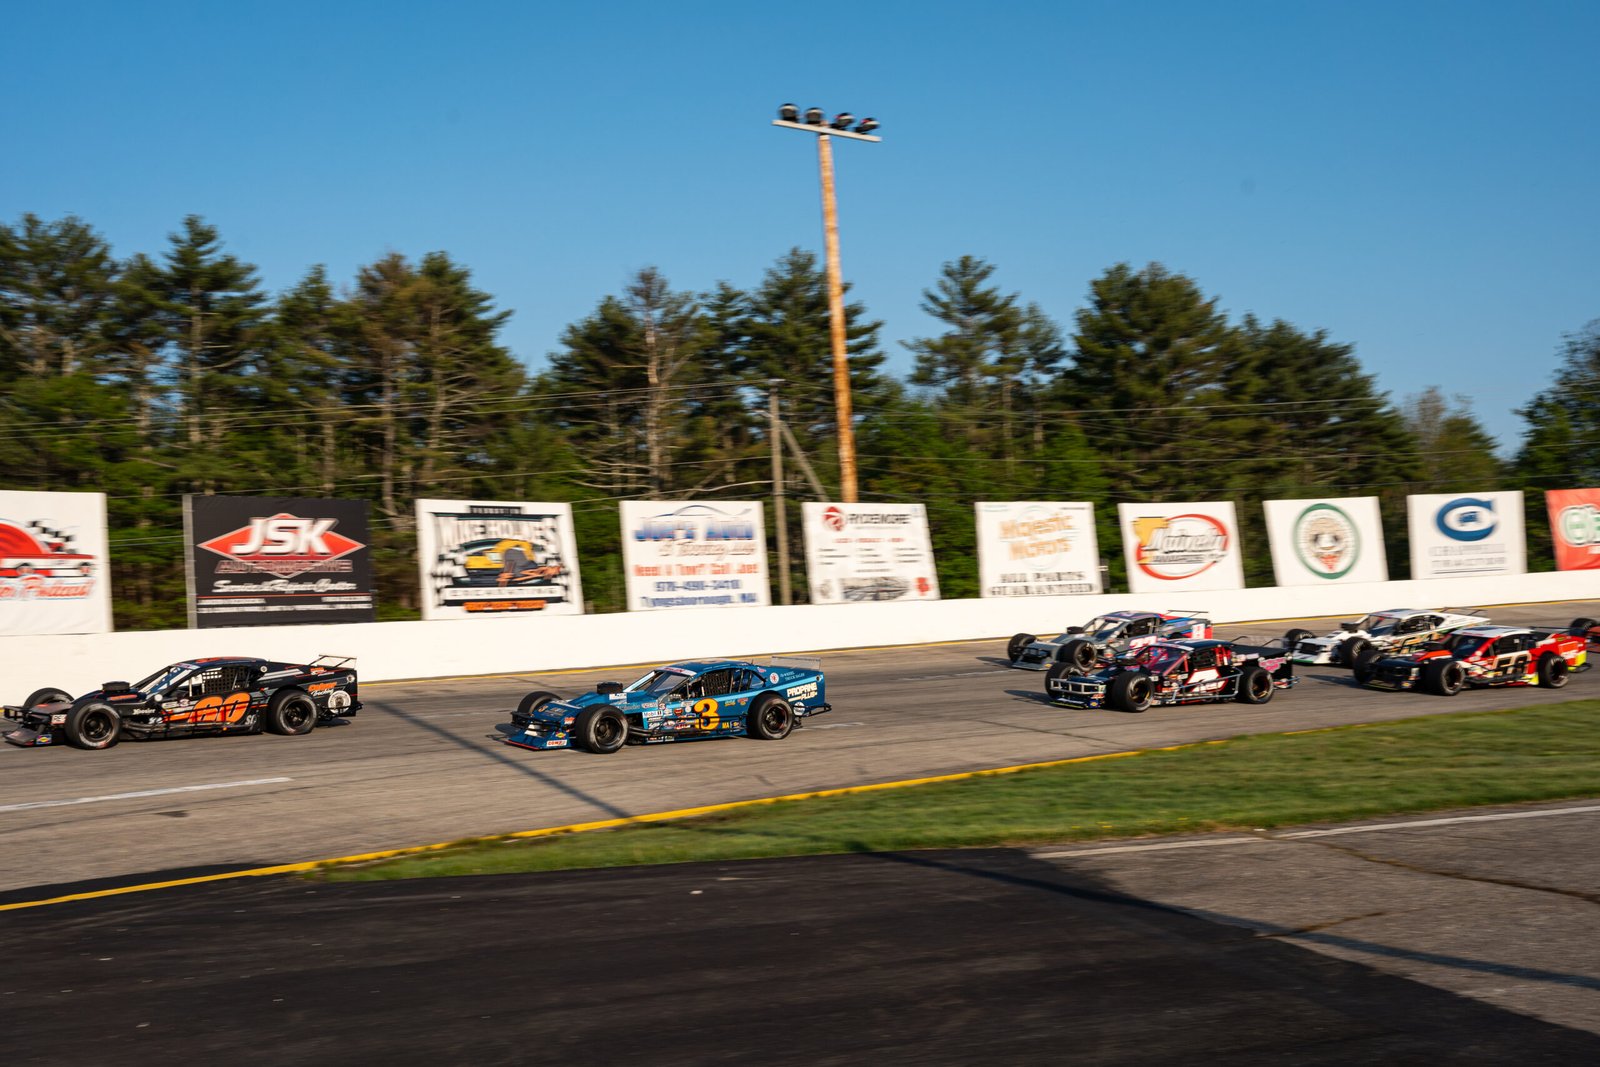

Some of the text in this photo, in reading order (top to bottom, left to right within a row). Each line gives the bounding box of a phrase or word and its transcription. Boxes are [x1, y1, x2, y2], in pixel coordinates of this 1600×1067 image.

[230, 517, 338, 555] JSK
[1031, 571, 1086, 582] PARTS
[989, 583, 1094, 596] GUARANTEED
[787, 682, 818, 697] PROPANE
[693, 698, 720, 730] 3
